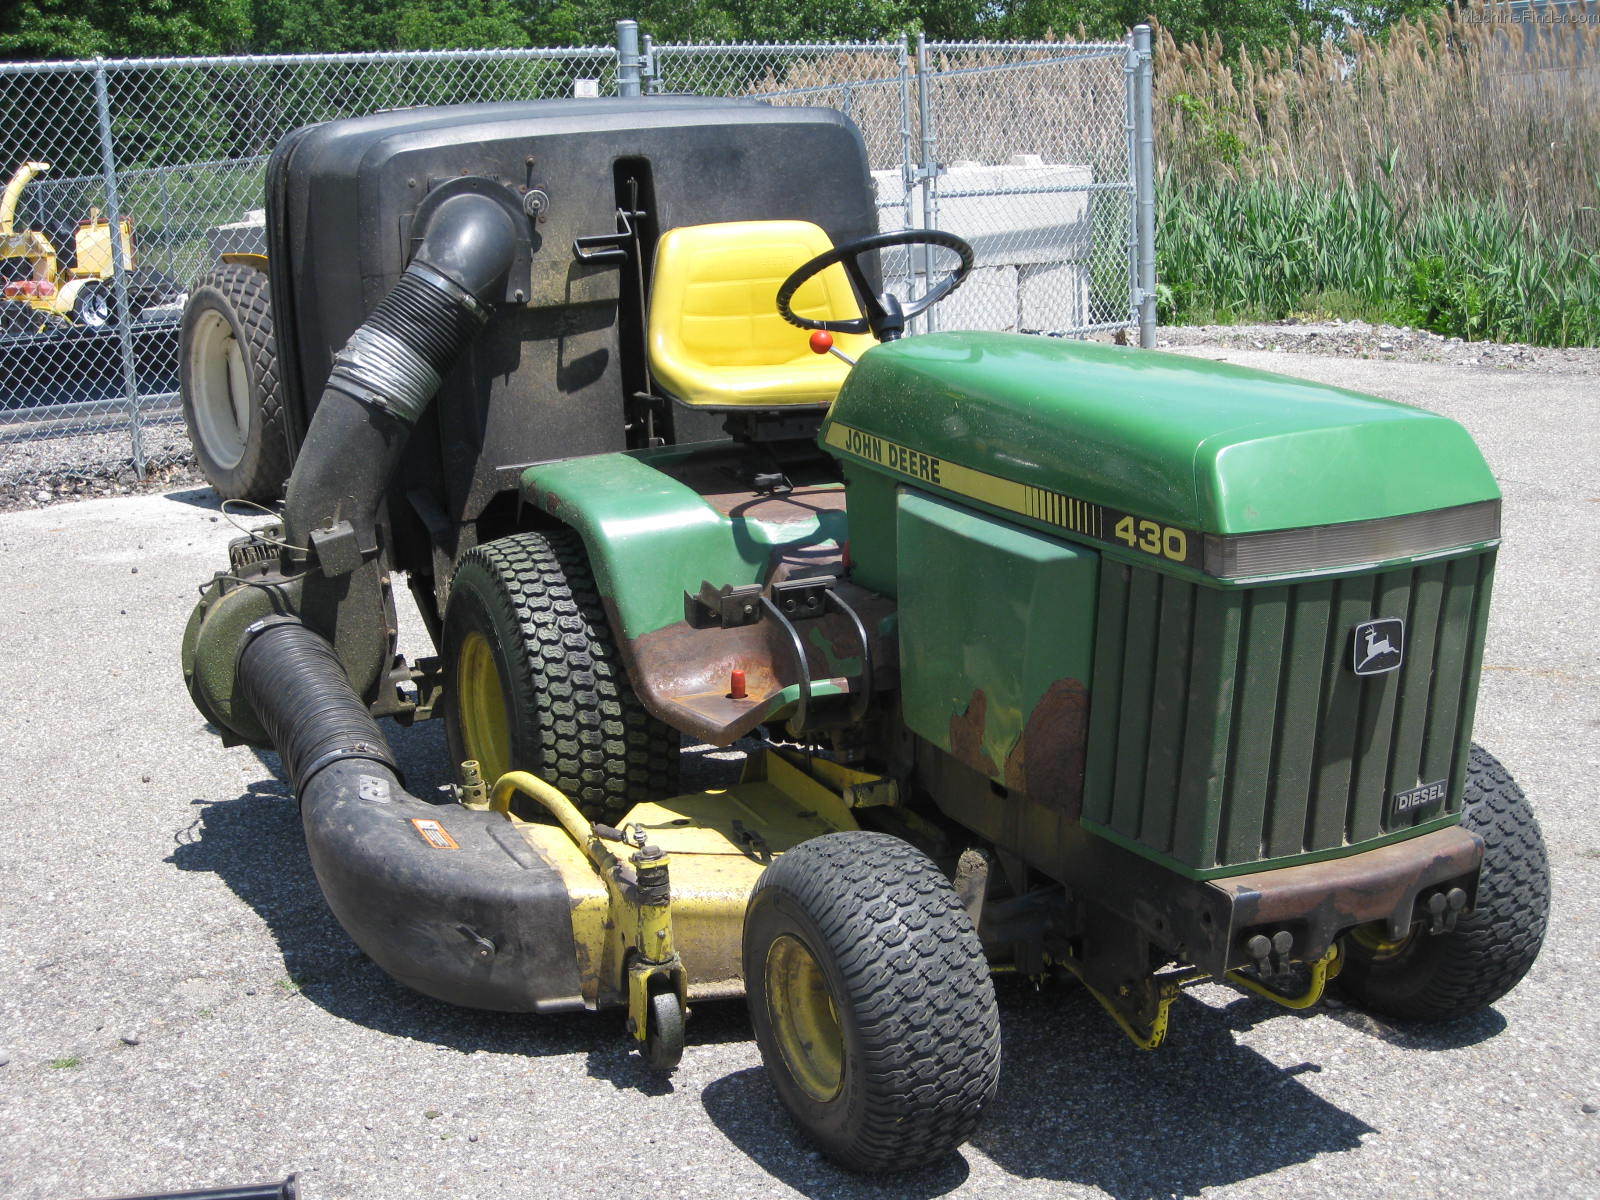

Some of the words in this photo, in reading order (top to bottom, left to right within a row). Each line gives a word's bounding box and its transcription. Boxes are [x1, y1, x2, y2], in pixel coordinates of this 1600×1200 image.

[845, 429, 882, 463] JOHN
[888, 443, 941, 485] DEERE
[1115, 515, 1187, 562] 430
[1398, 784, 1444, 810] DIESEL
